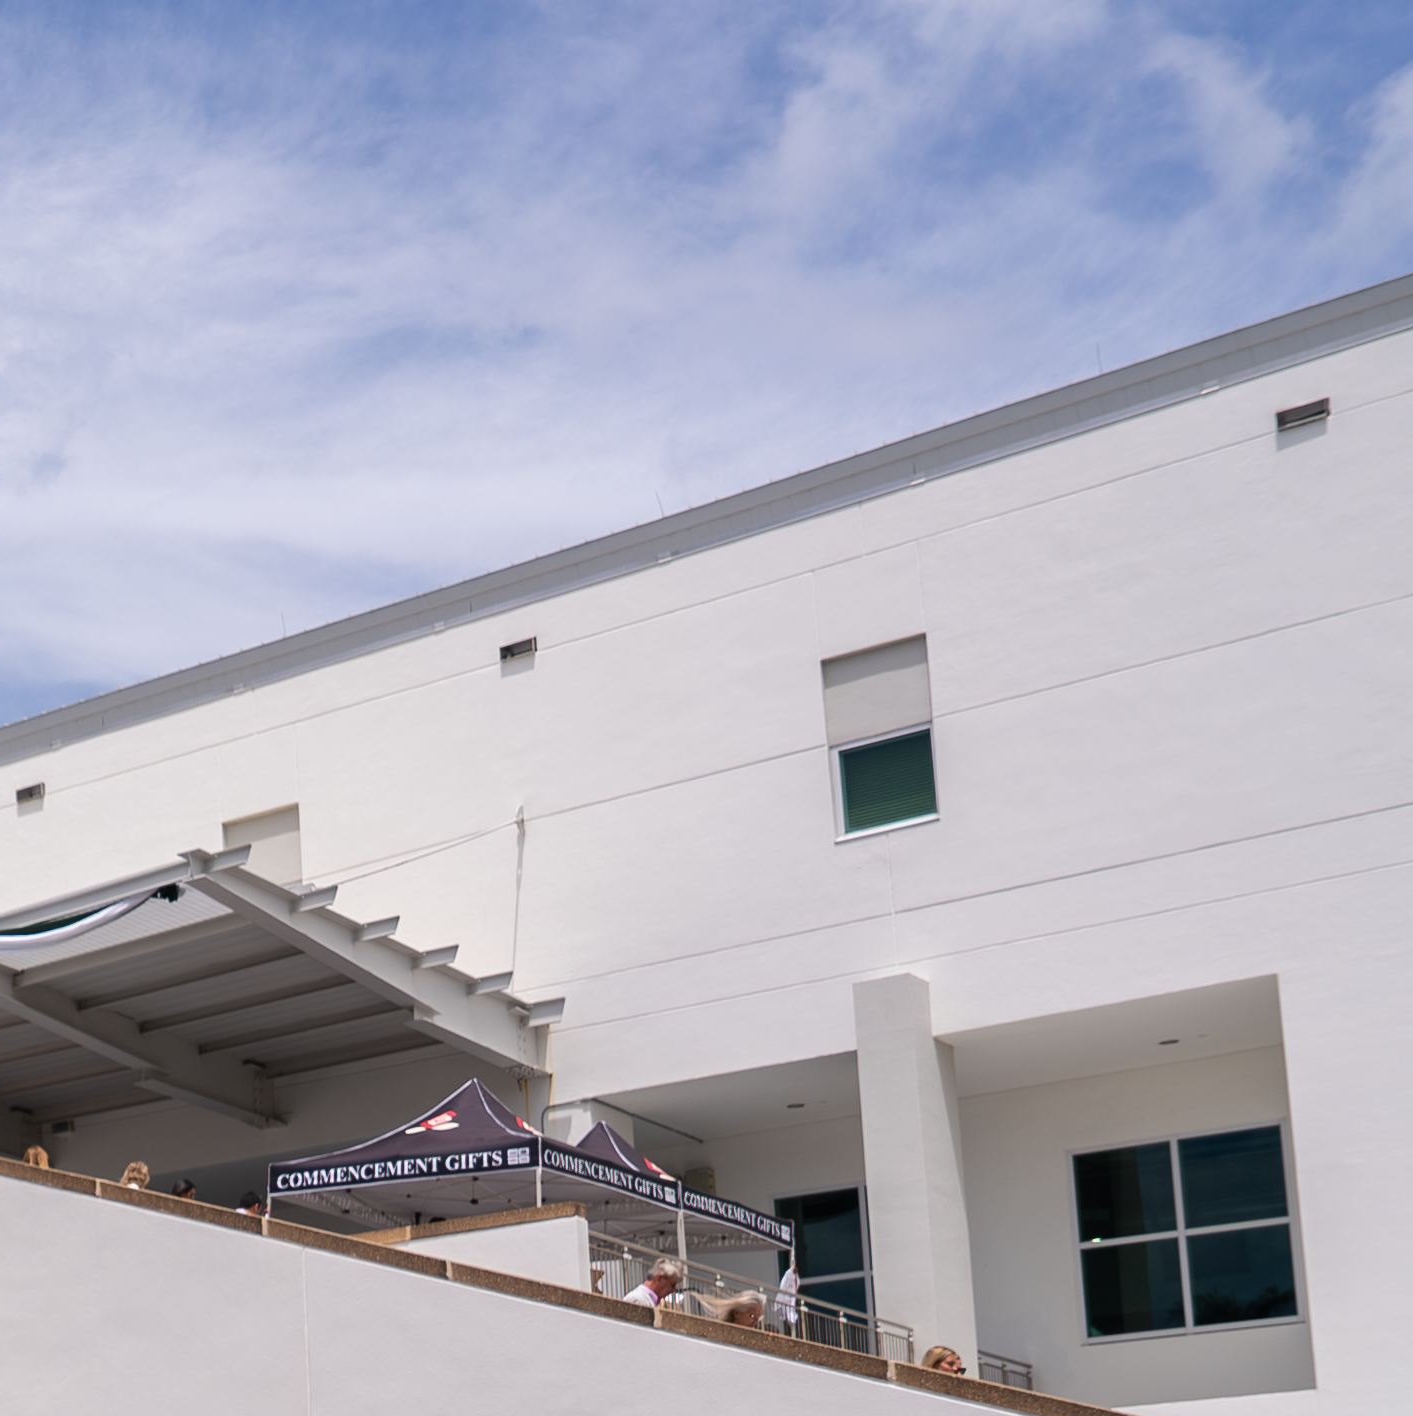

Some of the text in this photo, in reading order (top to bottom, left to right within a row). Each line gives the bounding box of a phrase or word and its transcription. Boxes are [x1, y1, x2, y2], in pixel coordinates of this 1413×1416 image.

[276, 1150, 503, 1189] COMMENCEMENT GIFTS
[544, 1148, 663, 1200] COMMENCEMENT GIFTS
[684, 1191, 757, 1228] COMMENCEMENT
[757, 1216, 781, 1238] GIFTS
